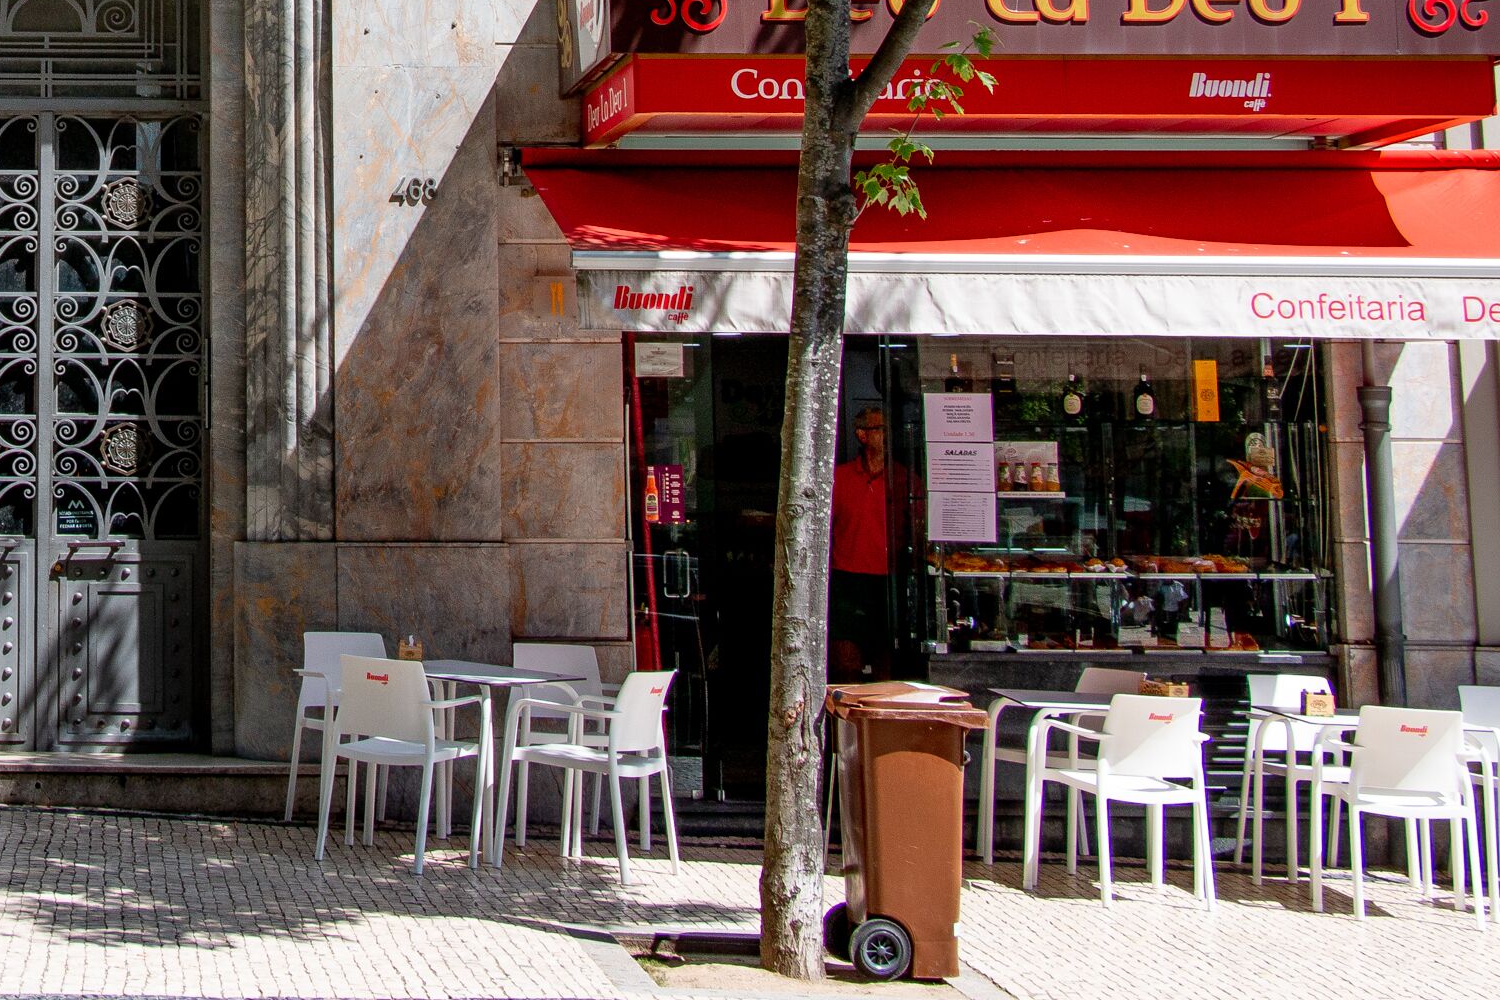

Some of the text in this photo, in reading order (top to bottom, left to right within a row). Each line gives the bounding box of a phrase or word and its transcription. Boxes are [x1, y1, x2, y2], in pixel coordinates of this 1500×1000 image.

[1188, 72, 1272, 98] Buondi
[388, 176, 437, 207] 468
[613, 285, 694, 311] Buondi
[1250, 292, 1426, 321] Confeitaria
